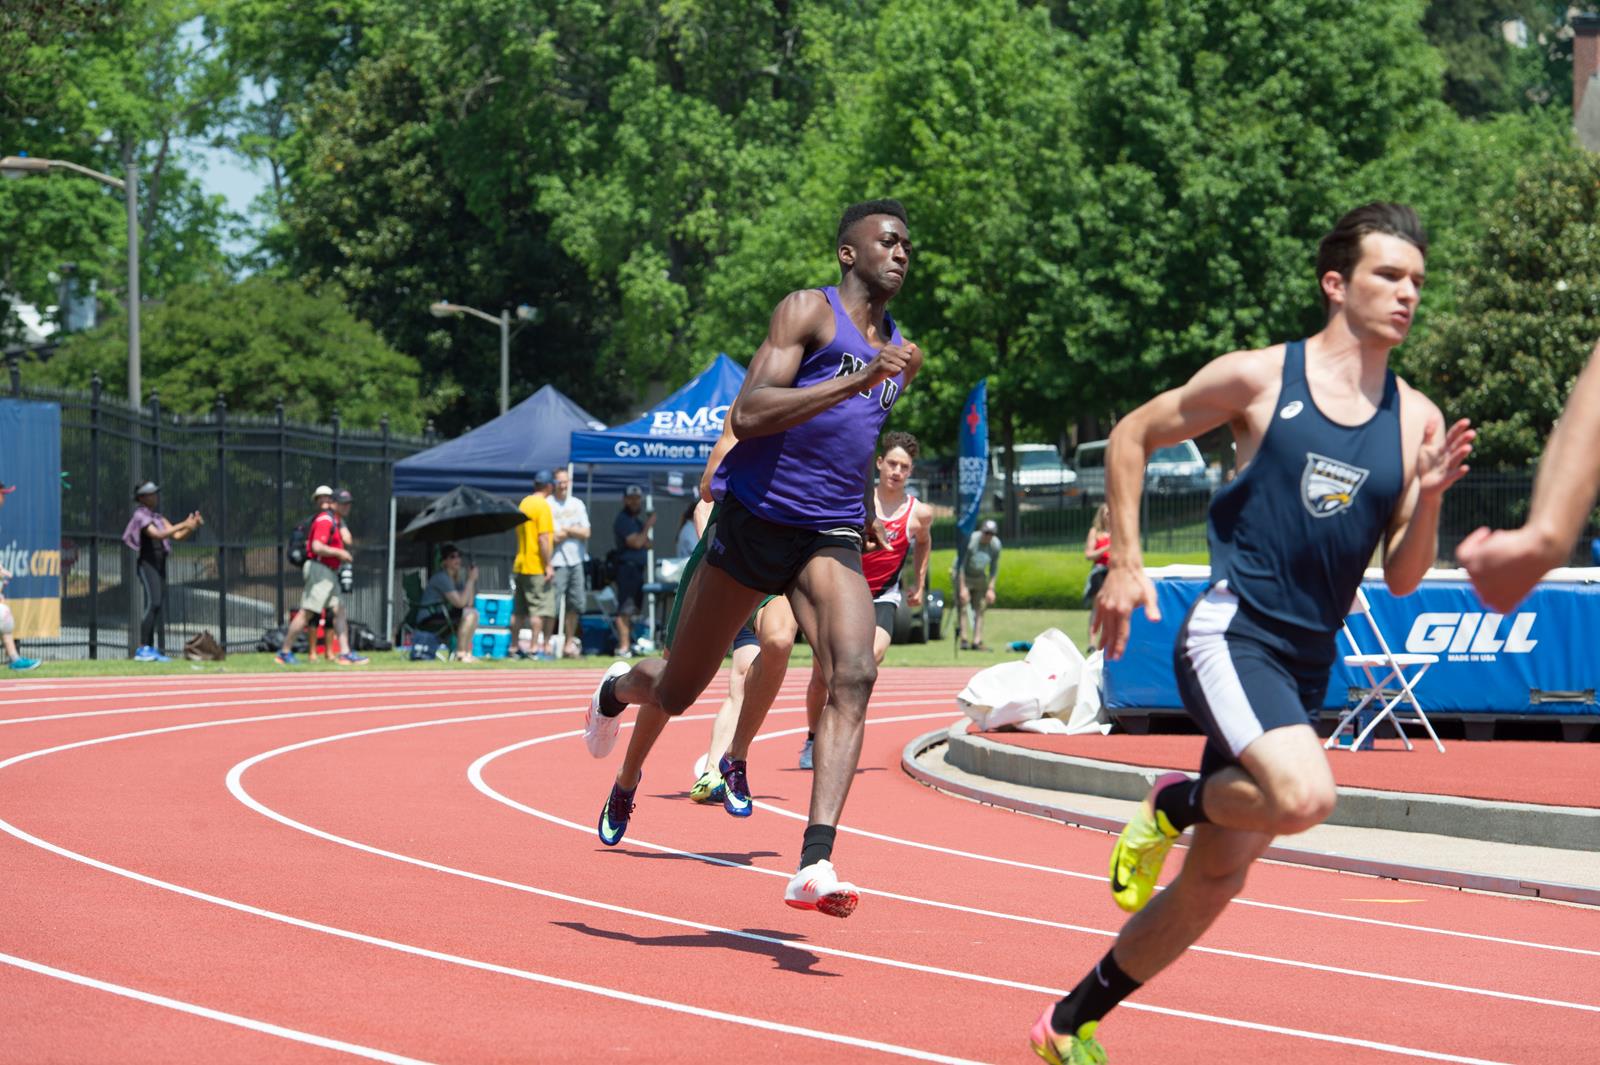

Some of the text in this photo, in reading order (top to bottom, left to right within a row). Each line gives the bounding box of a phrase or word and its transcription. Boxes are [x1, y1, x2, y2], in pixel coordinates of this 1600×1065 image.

[833, 352, 899, 411] NU
[614, 441, 641, 457] Go
[643, 442, 695, 459] Where
[1405, 612, 1538, 653] GILL
